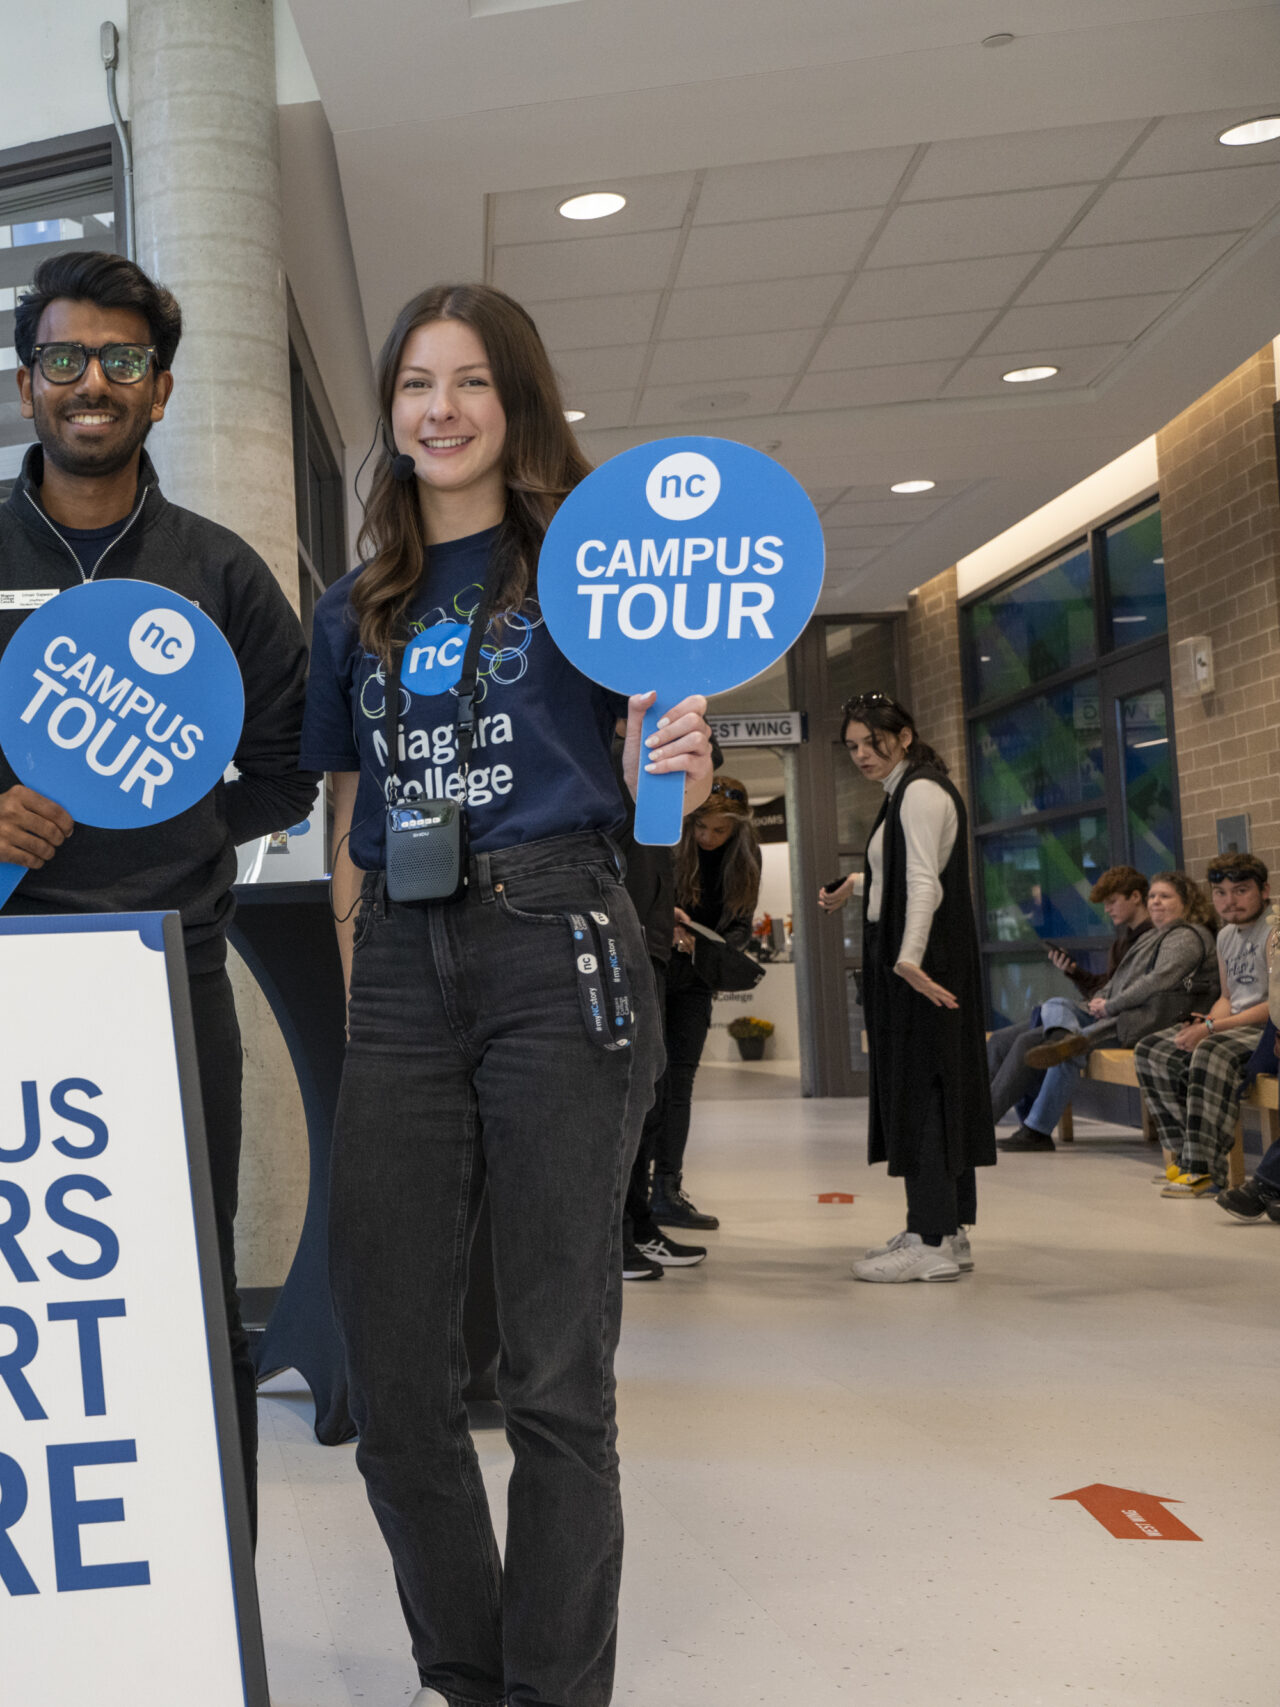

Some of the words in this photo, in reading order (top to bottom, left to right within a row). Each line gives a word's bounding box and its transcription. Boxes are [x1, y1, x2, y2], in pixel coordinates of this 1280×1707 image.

[660, 474, 705, 498] nc
[575, 535, 784, 578] CAMPUS
[577, 582, 775, 640] TOUR
[140, 622, 182, 660] nc
[409, 637, 463, 673] nc
[44, 635, 204, 761] CAMPUS
[20, 668, 184, 809] TOUR
[710, 722, 741, 738] EST
[745, 720, 792, 737] WING
[582, 957, 592, 970] nc
